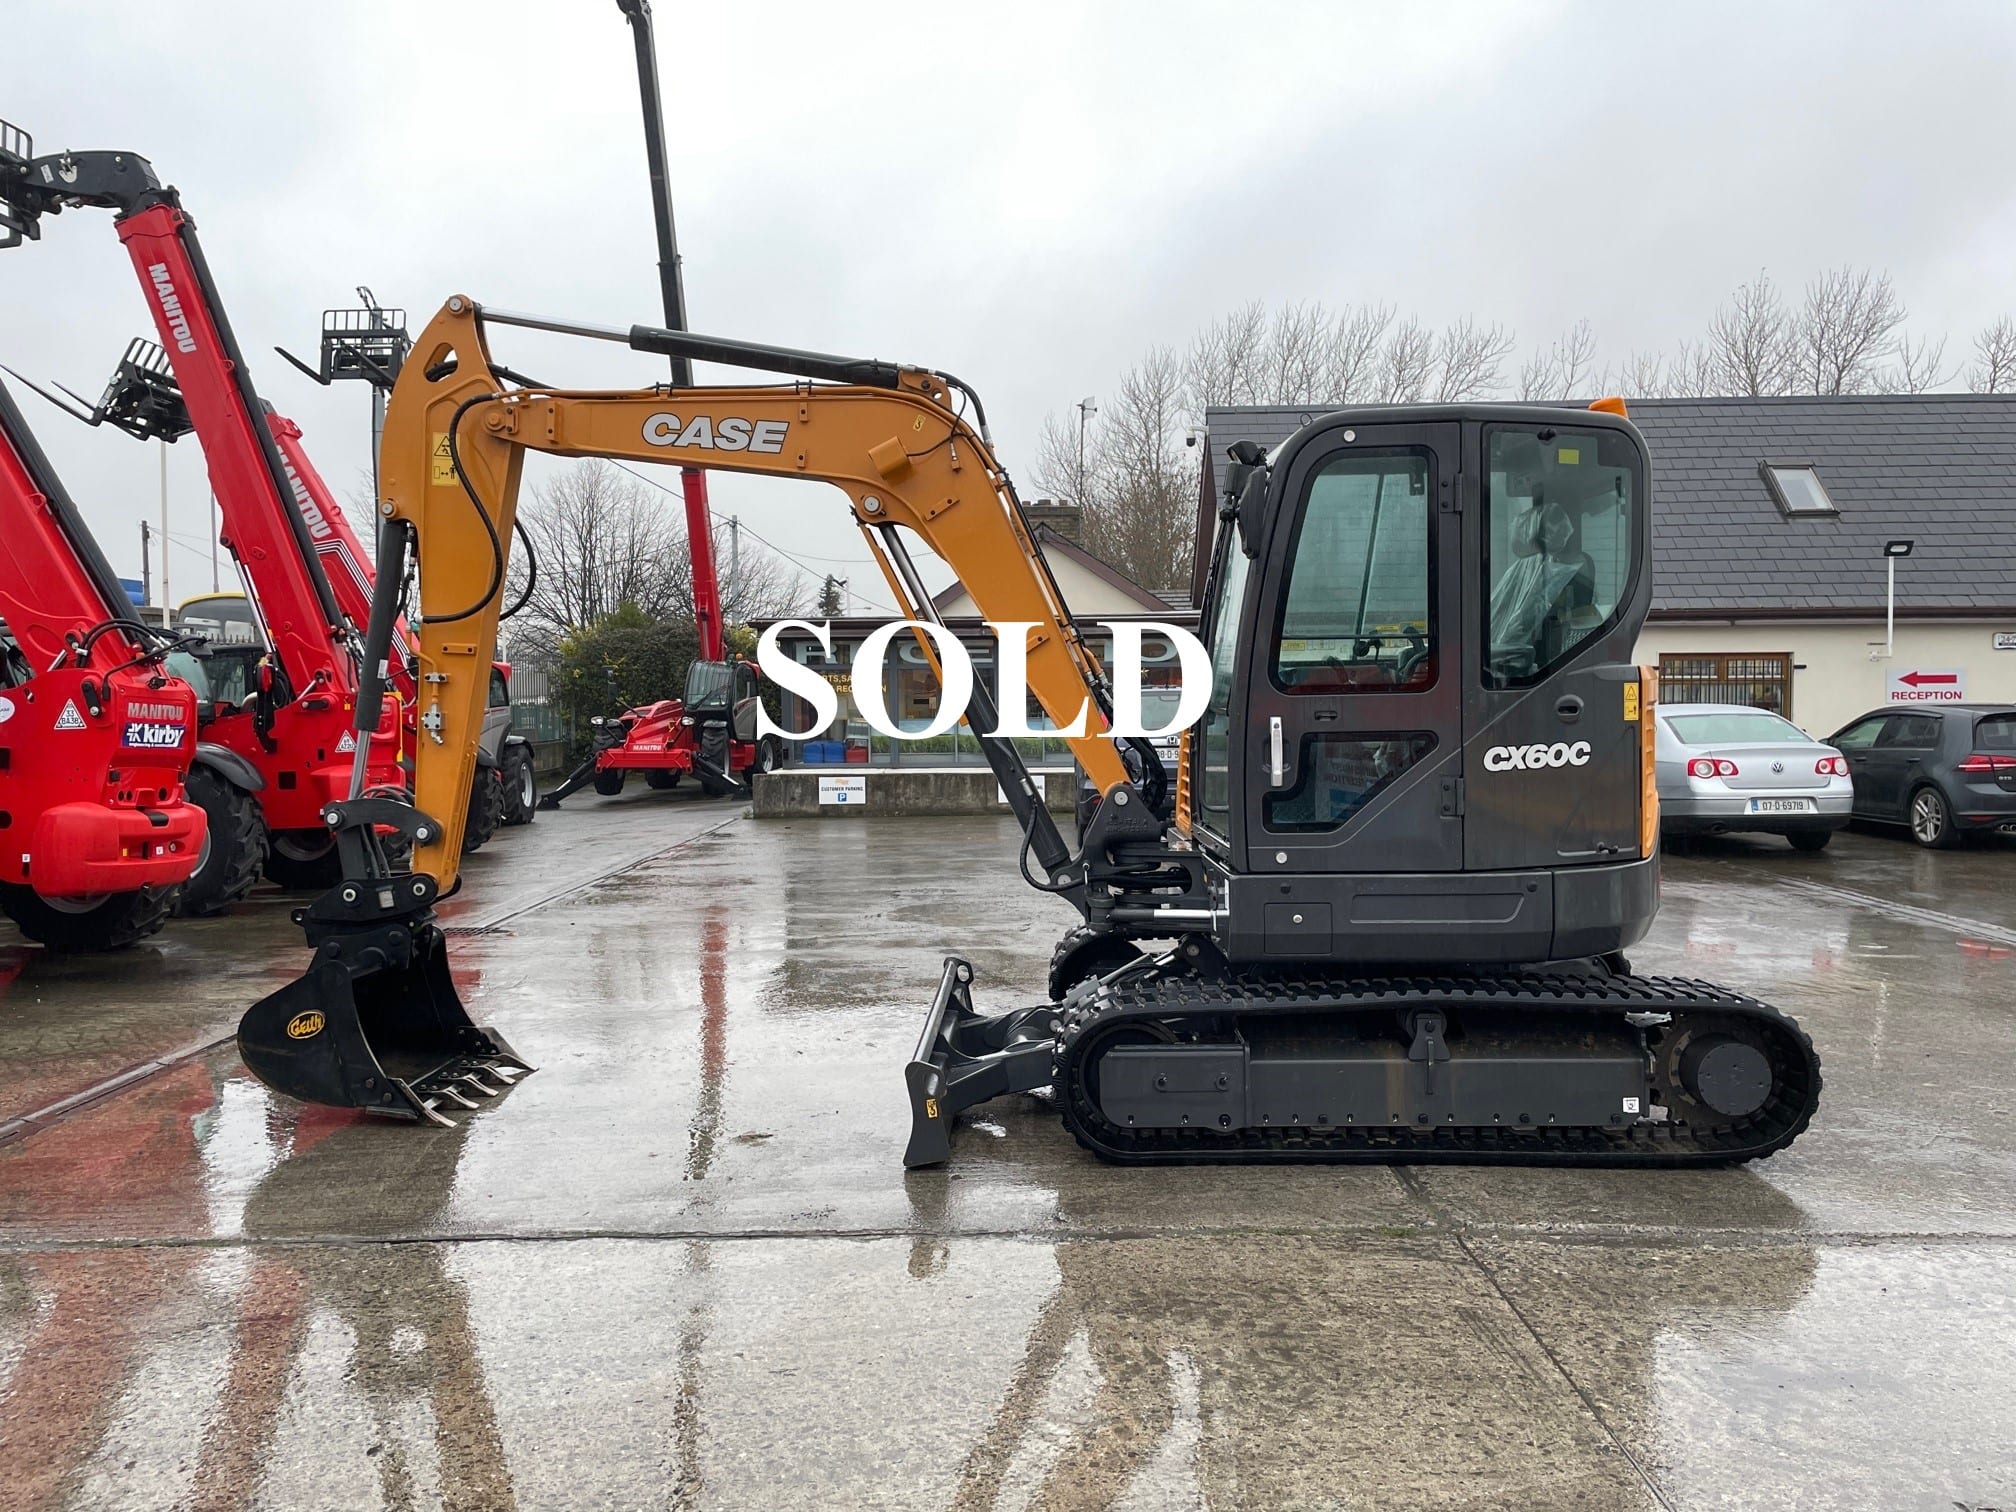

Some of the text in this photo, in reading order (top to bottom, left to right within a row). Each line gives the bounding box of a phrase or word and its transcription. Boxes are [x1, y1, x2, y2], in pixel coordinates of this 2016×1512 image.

[148, 263, 197, 353] MANITOU
[642, 412, 790, 454] CASE
[127, 702, 184, 721] MANITOU
[1891, 691, 1962, 700] RECEPTION
[1483, 740, 1592, 772] CX60C
